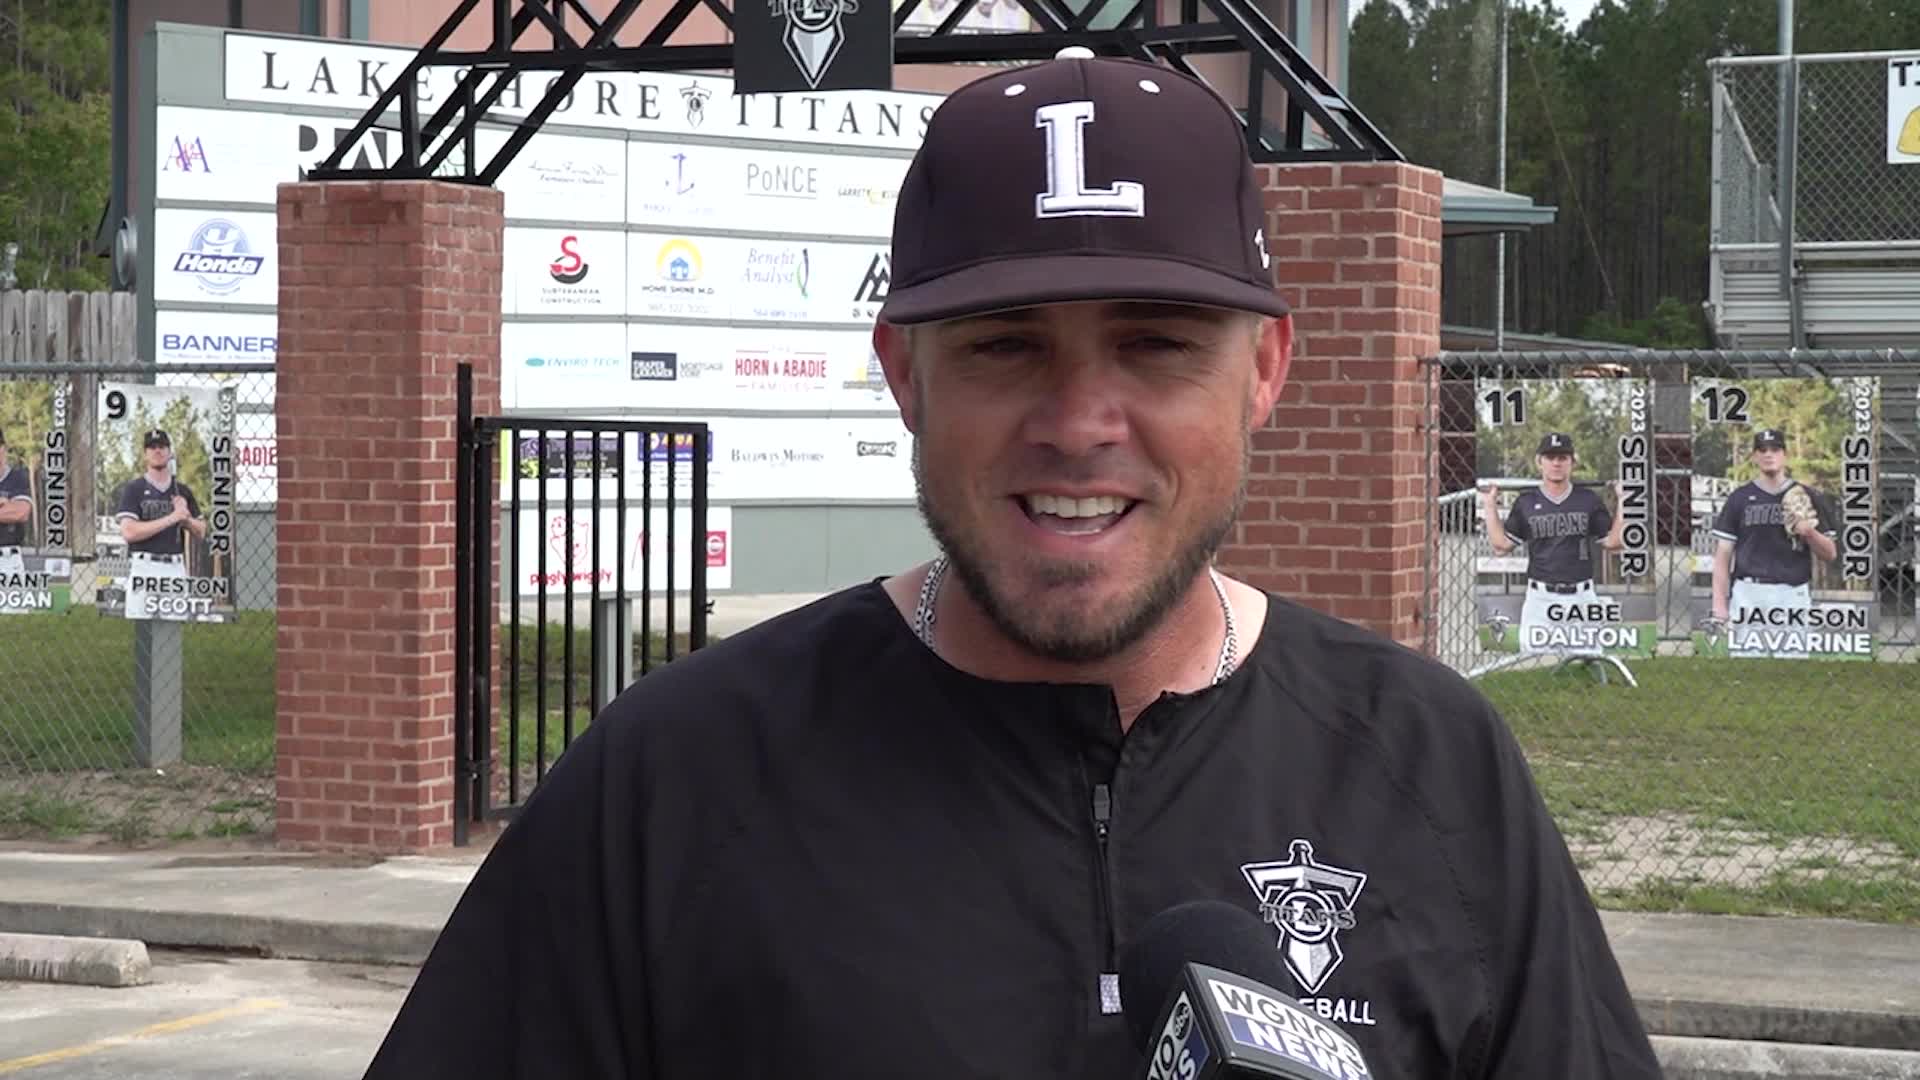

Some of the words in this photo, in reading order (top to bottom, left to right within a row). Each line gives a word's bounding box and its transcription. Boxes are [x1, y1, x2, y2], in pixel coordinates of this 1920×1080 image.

[731, 93, 935, 140] TITANS
[1036, 101, 1145, 218] L
[177, 253, 257, 274] Honda
[162, 334, 278, 352] BANNER
[735, 358, 769, 377] HORN
[783, 359, 827, 378] ABADIE
[106, 391, 127, 419] 9
[1485, 390, 1524, 423] 11
[1631, 387, 1646, 433] 2023
[1701, 387, 1747, 421] 12
[1855, 386, 1871, 433] 2023
[47, 432, 65, 547] SENIOR
[213, 436, 231, 553] SENIOR
[1622, 438, 1646, 574] SENIOR
[1845, 438, 1871, 577] SENIOR
[1529, 513, 1589, 538] TITANS
[132, 576, 226, 594] PRESTON
[145, 597, 213, 614] SCOTT
[1547, 604, 1620, 622] GABE
[1733, 607, 1865, 627] JACKSON
[1531, 628, 1638, 648] DALTON
[1728, 631, 1871, 653] LAVARINE
[1259, 902, 1357, 930] TITANS
[1217, 984, 1338, 1051] WGNO
[1246, 1018, 1362, 1080] NEWS
